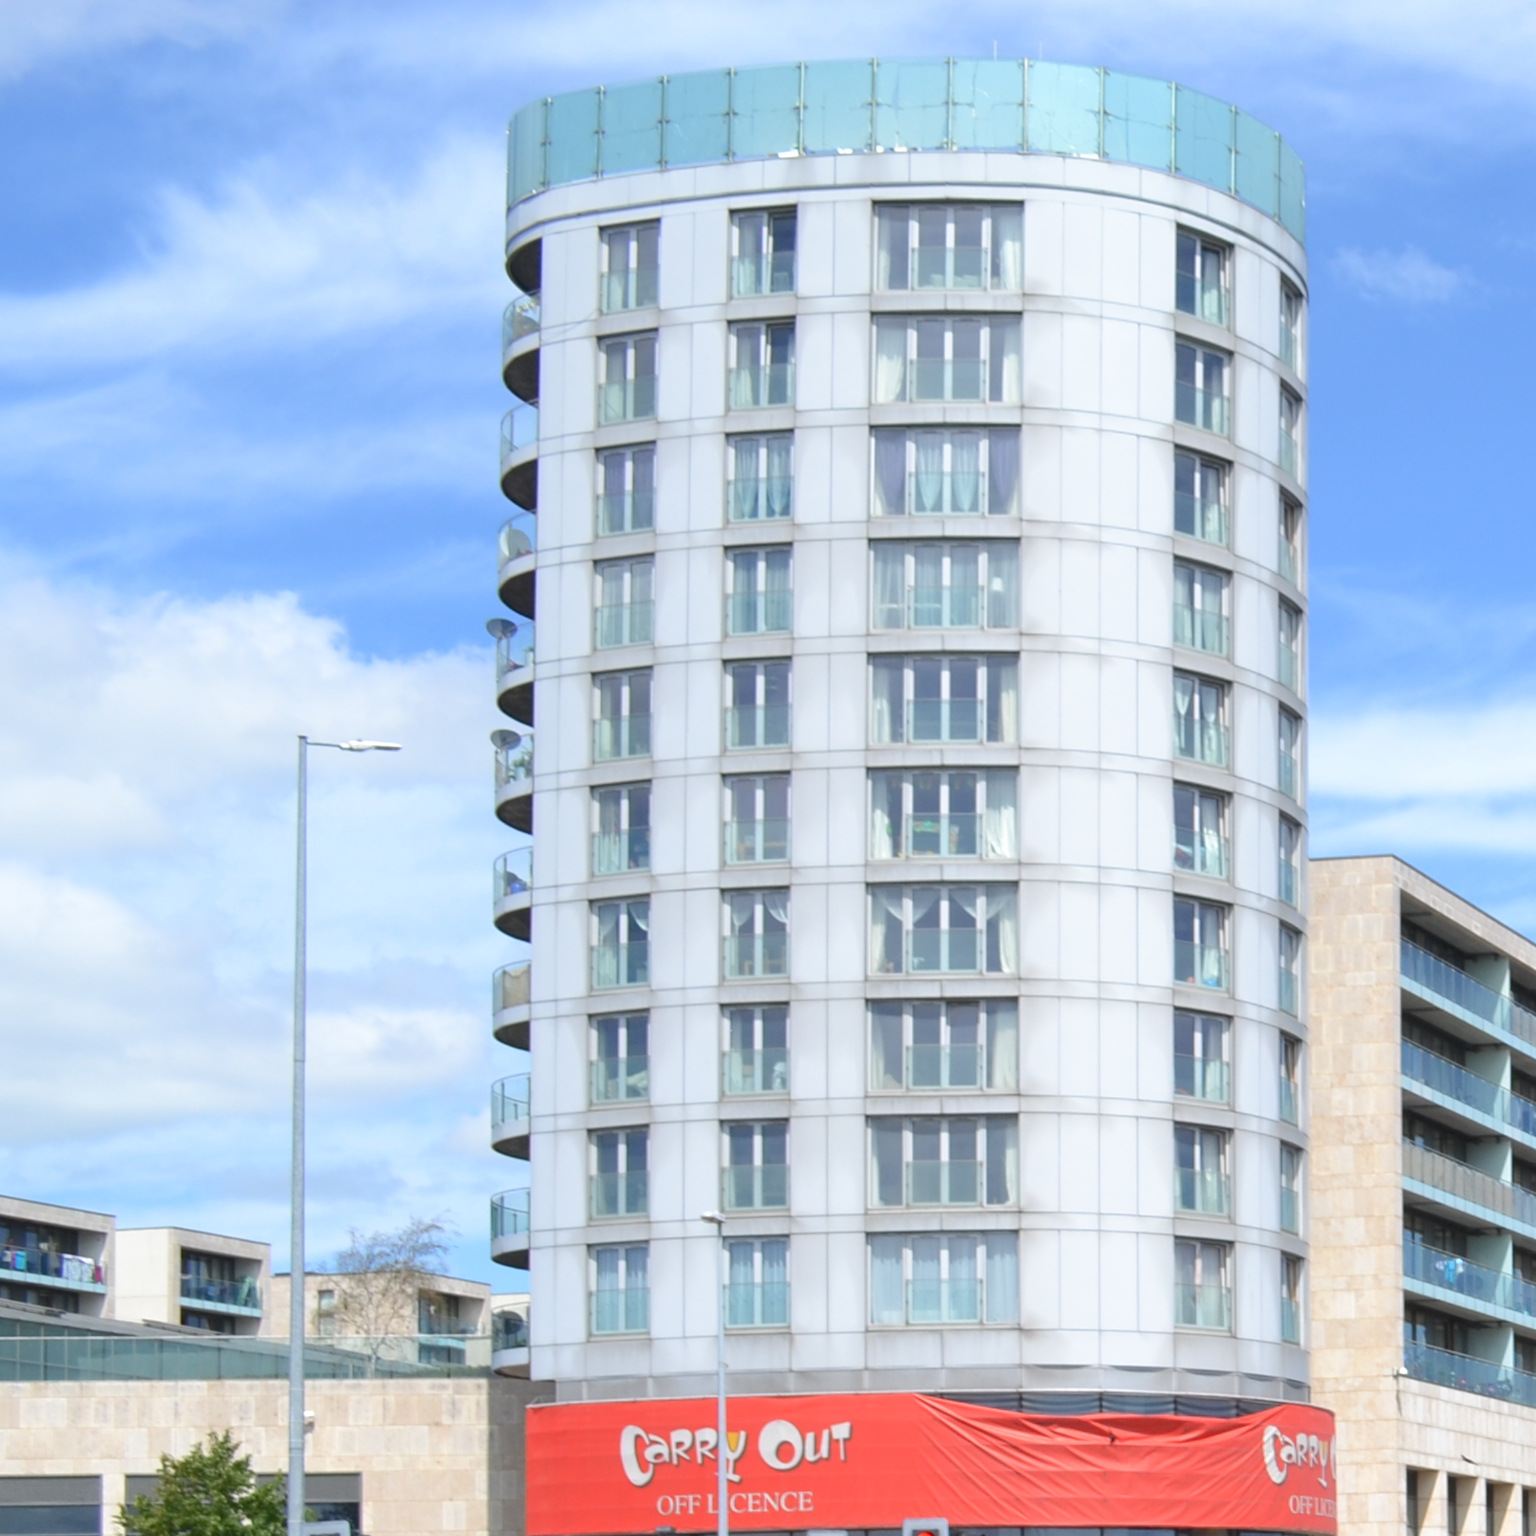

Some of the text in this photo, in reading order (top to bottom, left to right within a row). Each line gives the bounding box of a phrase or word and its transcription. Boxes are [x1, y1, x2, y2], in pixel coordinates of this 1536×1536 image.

[656, 1491, 813, 1516] OFF LCENCE
[1289, 1495, 1313, 1514] OFF
